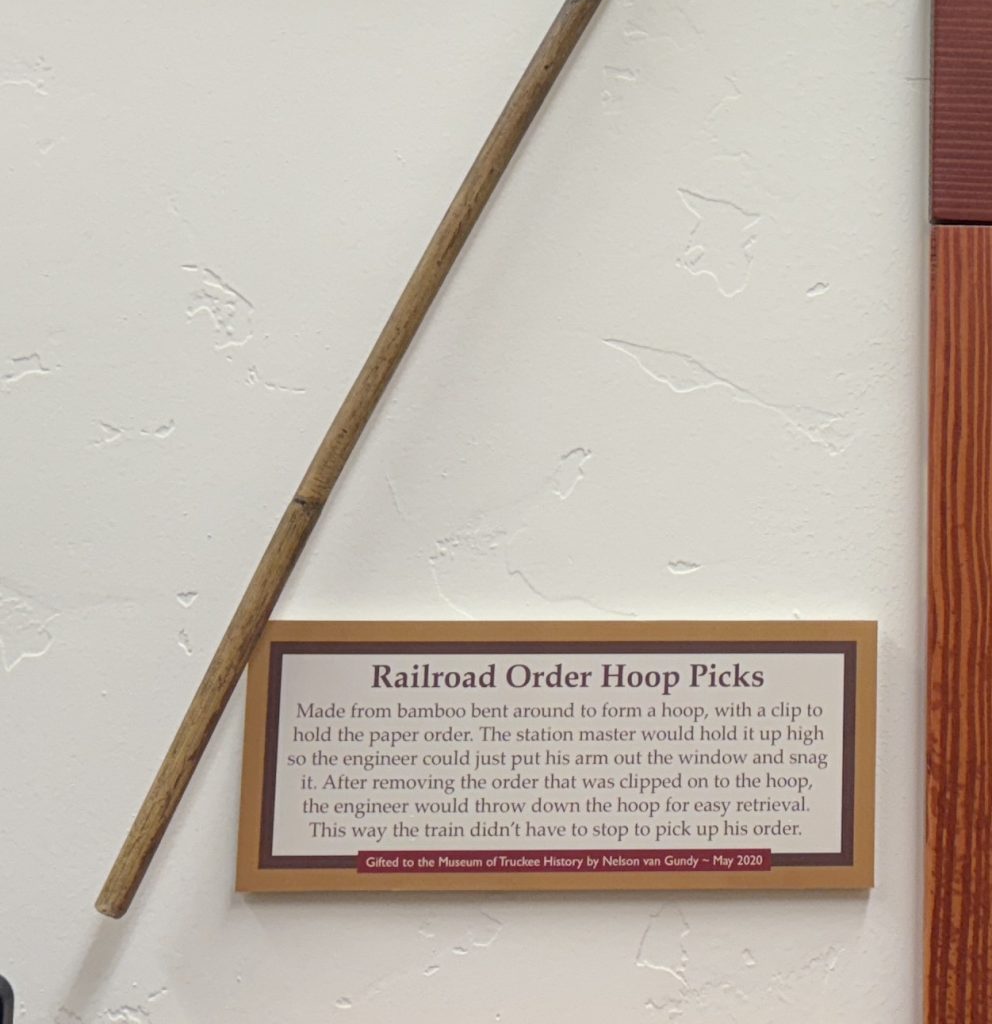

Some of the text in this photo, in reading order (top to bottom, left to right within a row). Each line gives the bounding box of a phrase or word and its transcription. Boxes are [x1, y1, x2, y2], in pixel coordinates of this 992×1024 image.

[370, 662, 765, 697] Railroad Order Hoop Picks
[296, 700, 824, 724] Made from bamboo bent around to form a hoop, with a clip to
[292, 724, 825, 748] hold the paper order. The station master would hold it up high
[287, 748, 829, 772] so the engineer could just put his arm out the window and snag
[300, 771, 813, 796] it. After removing the order that was clipped on to the hoop,
[302, 795, 811, 820] the engineer would throw down the hoop for easy retrieval.
[308, 821, 347, 838] This
[351, 823, 388, 843] way
[392, 820, 420, 838] the
[424, 821, 465, 838] train
[525, 820, 567, 838] have
[571, 822, 589, 838] to
[591, 822, 630, 843] stop
[634, 822, 651, 837] to
[654, 819, 692, 843] pick
[696, 824, 720, 842] up
[723, 819, 749, 837] his
[752, 818, 803, 837] order.
[365, 856, 400, 868] Gifted
[402, 858, 415, 868] to
[417, 856, 436, 868] the
[438, 856, 483, 868] Museum
[485, 855, 499, 868] of
[498, 855, 541, 867] Truckee
[543, 855, 584, 870] History
[586, 855, 600, 870] by
[602, 855, 640, 867] Nelson
[643, 857, 661, 867] van
[664, 855, 699, 870] Gundy
[712, 855, 736, 869] May
[737, 855, 763, 866] 2020
